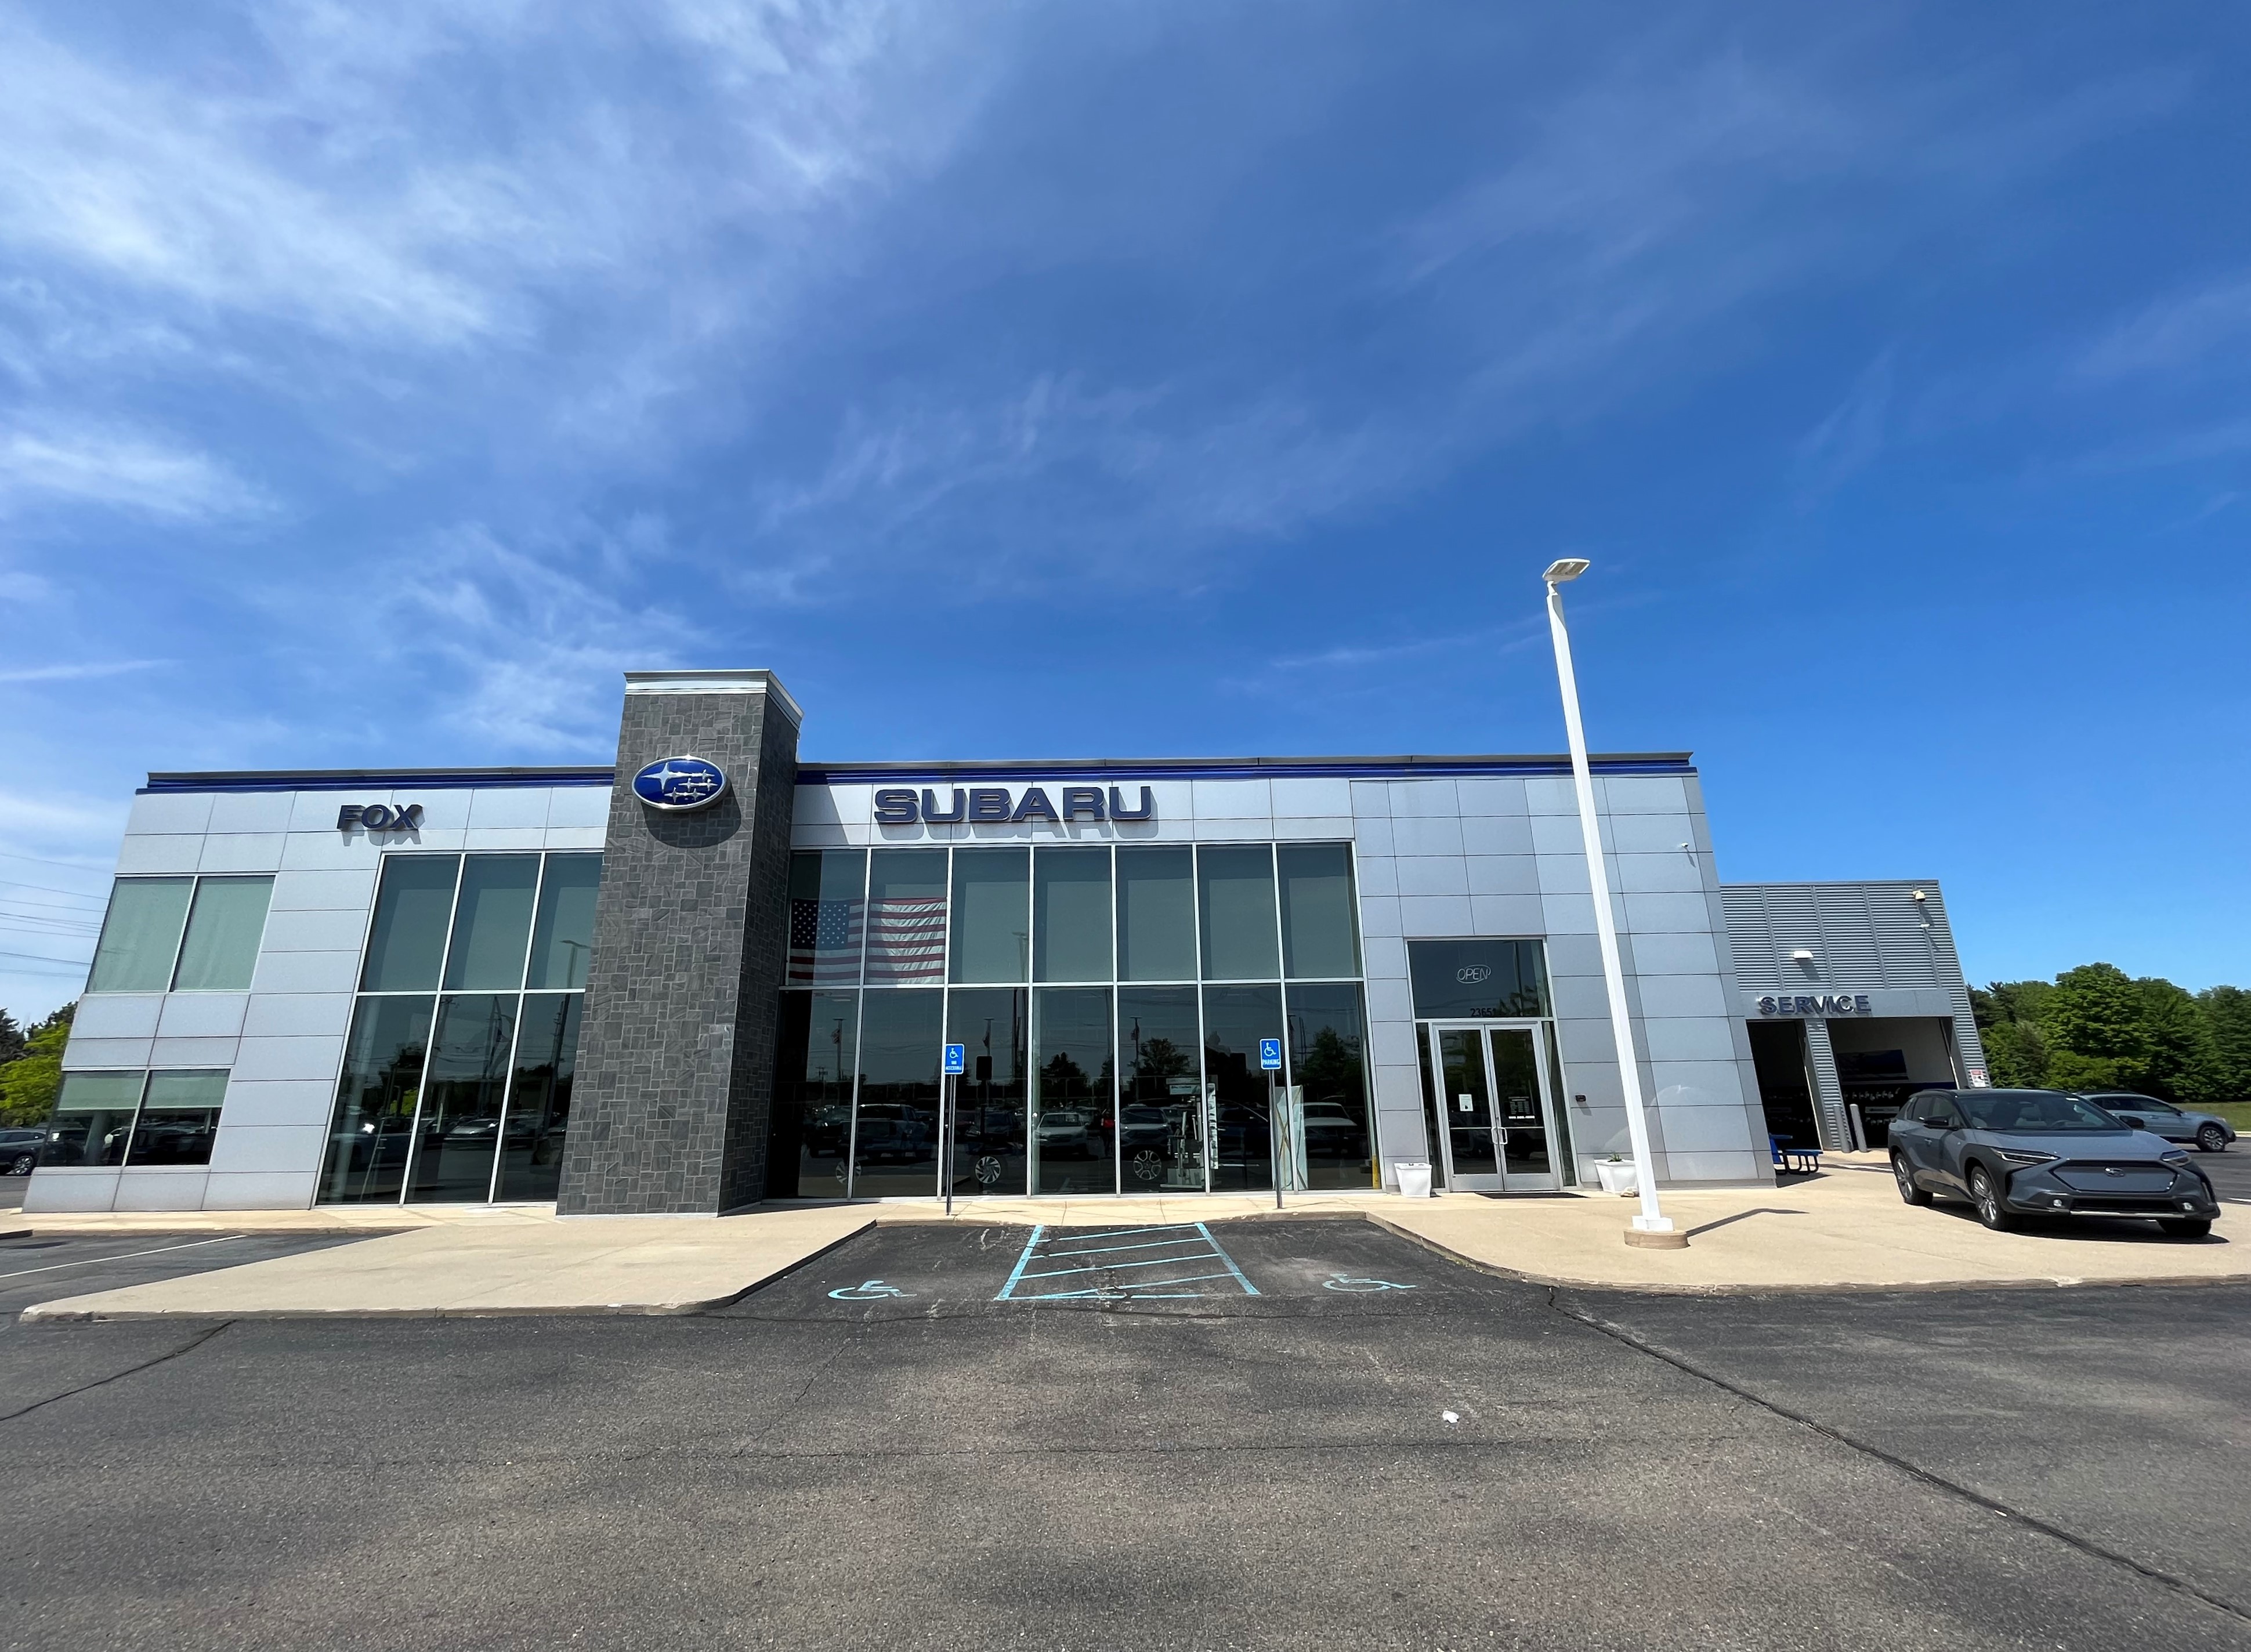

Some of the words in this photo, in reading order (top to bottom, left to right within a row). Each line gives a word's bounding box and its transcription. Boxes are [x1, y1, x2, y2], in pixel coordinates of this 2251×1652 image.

[874, 785, 1152, 823] SUBARU
[336, 804, 422, 829] FOX
[1457, 968, 1488, 980] OPEN
[1760, 995, 1872, 1014] SERVICE
